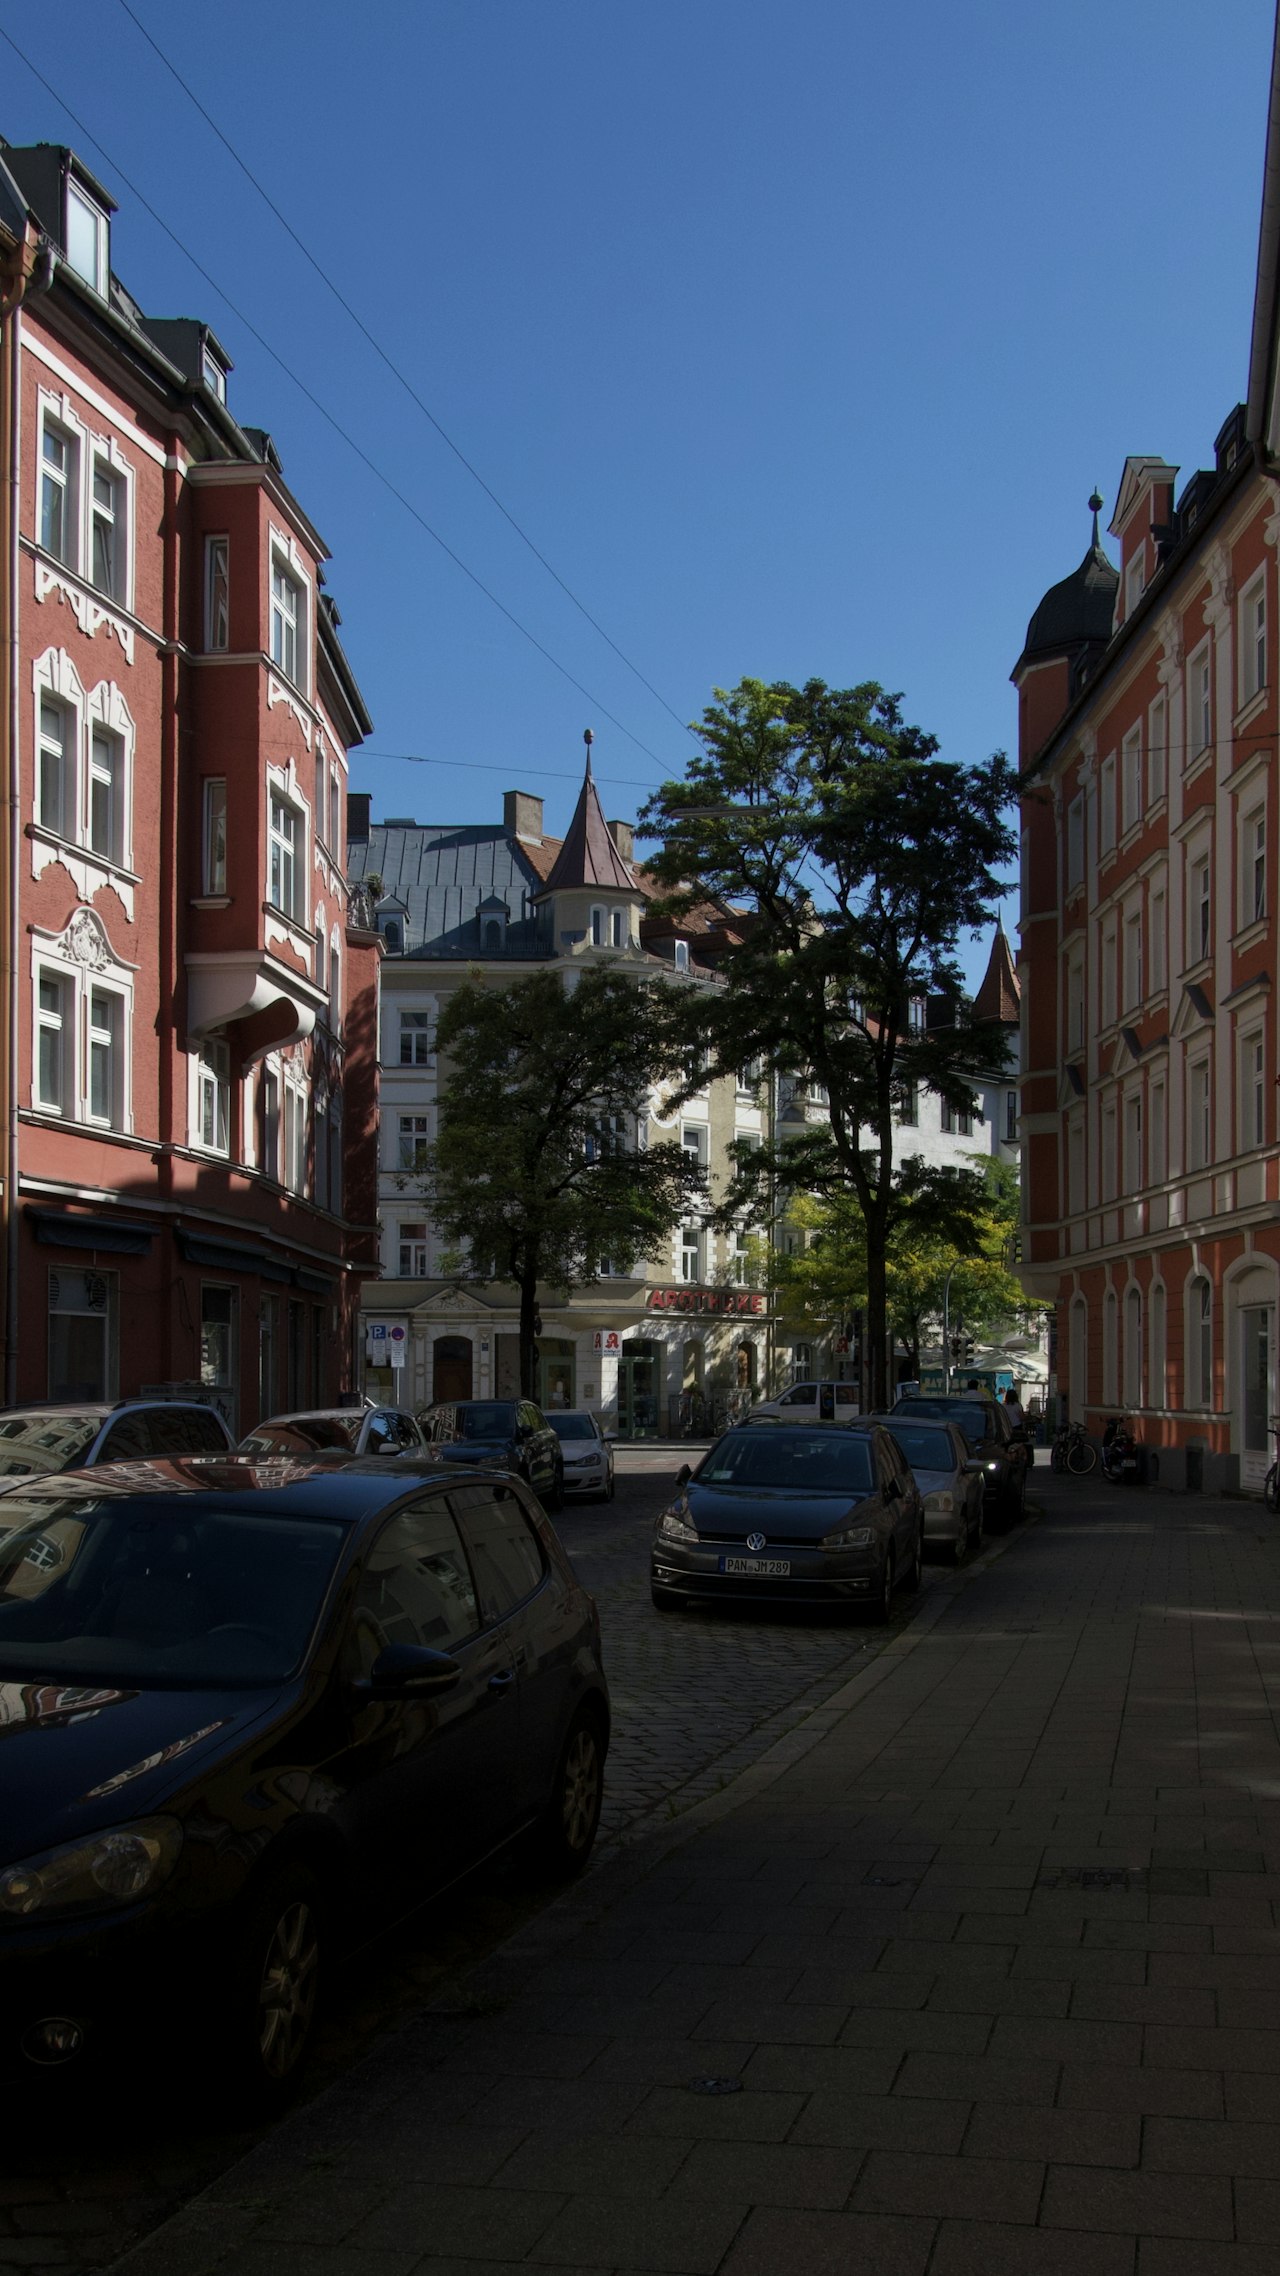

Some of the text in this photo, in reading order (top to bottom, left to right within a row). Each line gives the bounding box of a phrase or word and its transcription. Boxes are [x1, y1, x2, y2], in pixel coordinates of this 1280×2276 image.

[648, 1289, 763, 1313] APOTHEKE
[374, 1327, 383, 1338] P
[727, 1559, 789, 1574] PAN JM 289
